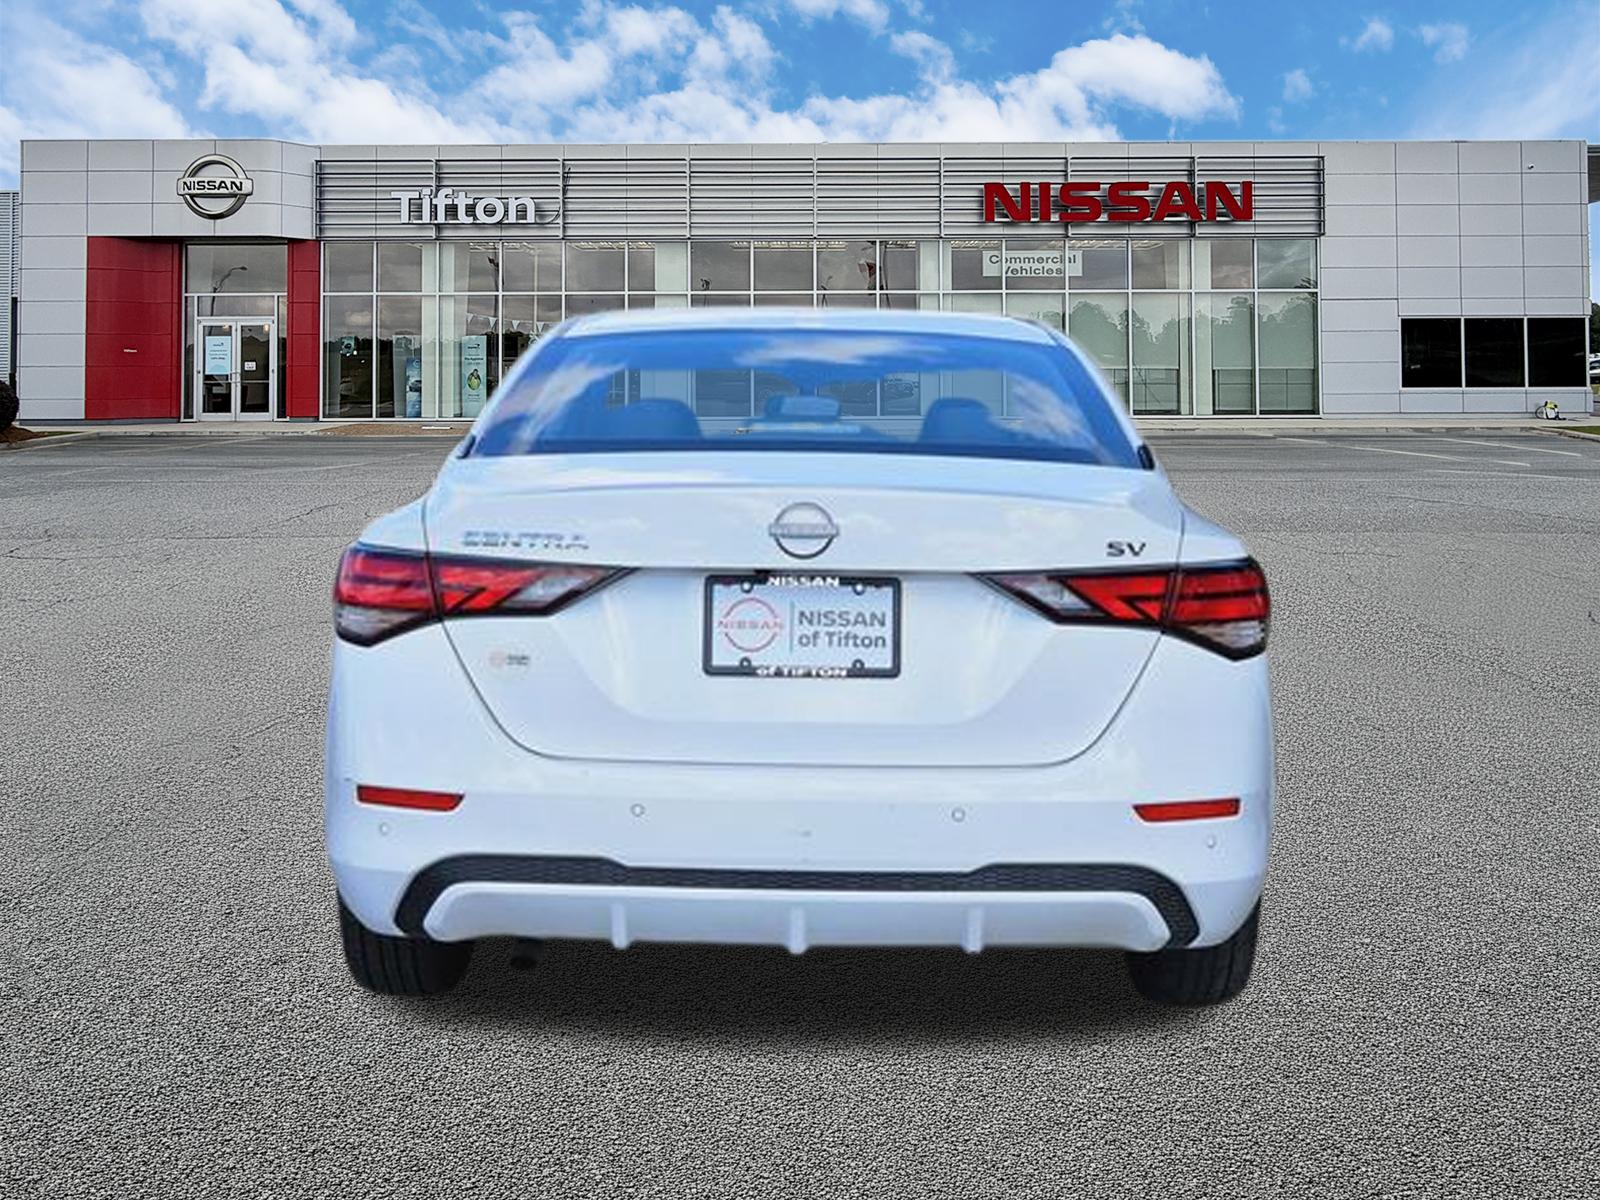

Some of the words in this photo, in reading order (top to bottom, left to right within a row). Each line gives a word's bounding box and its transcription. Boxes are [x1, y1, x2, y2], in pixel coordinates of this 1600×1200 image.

[182, 180, 243, 191] NISSAN
[391, 188, 536, 224] Tifton
[983, 180, 1253, 222] NISSAN
[988, 254, 1076, 264] Cmmercil
[1106, 542, 1146, 557] SV
[766, 576, 840, 587] NISSAN
[718, 620, 783, 630] NISSAN
[798, 611, 886, 628] NISSAN
[798, 631, 821, 647] of
[825, 631, 886, 648] Tifton
